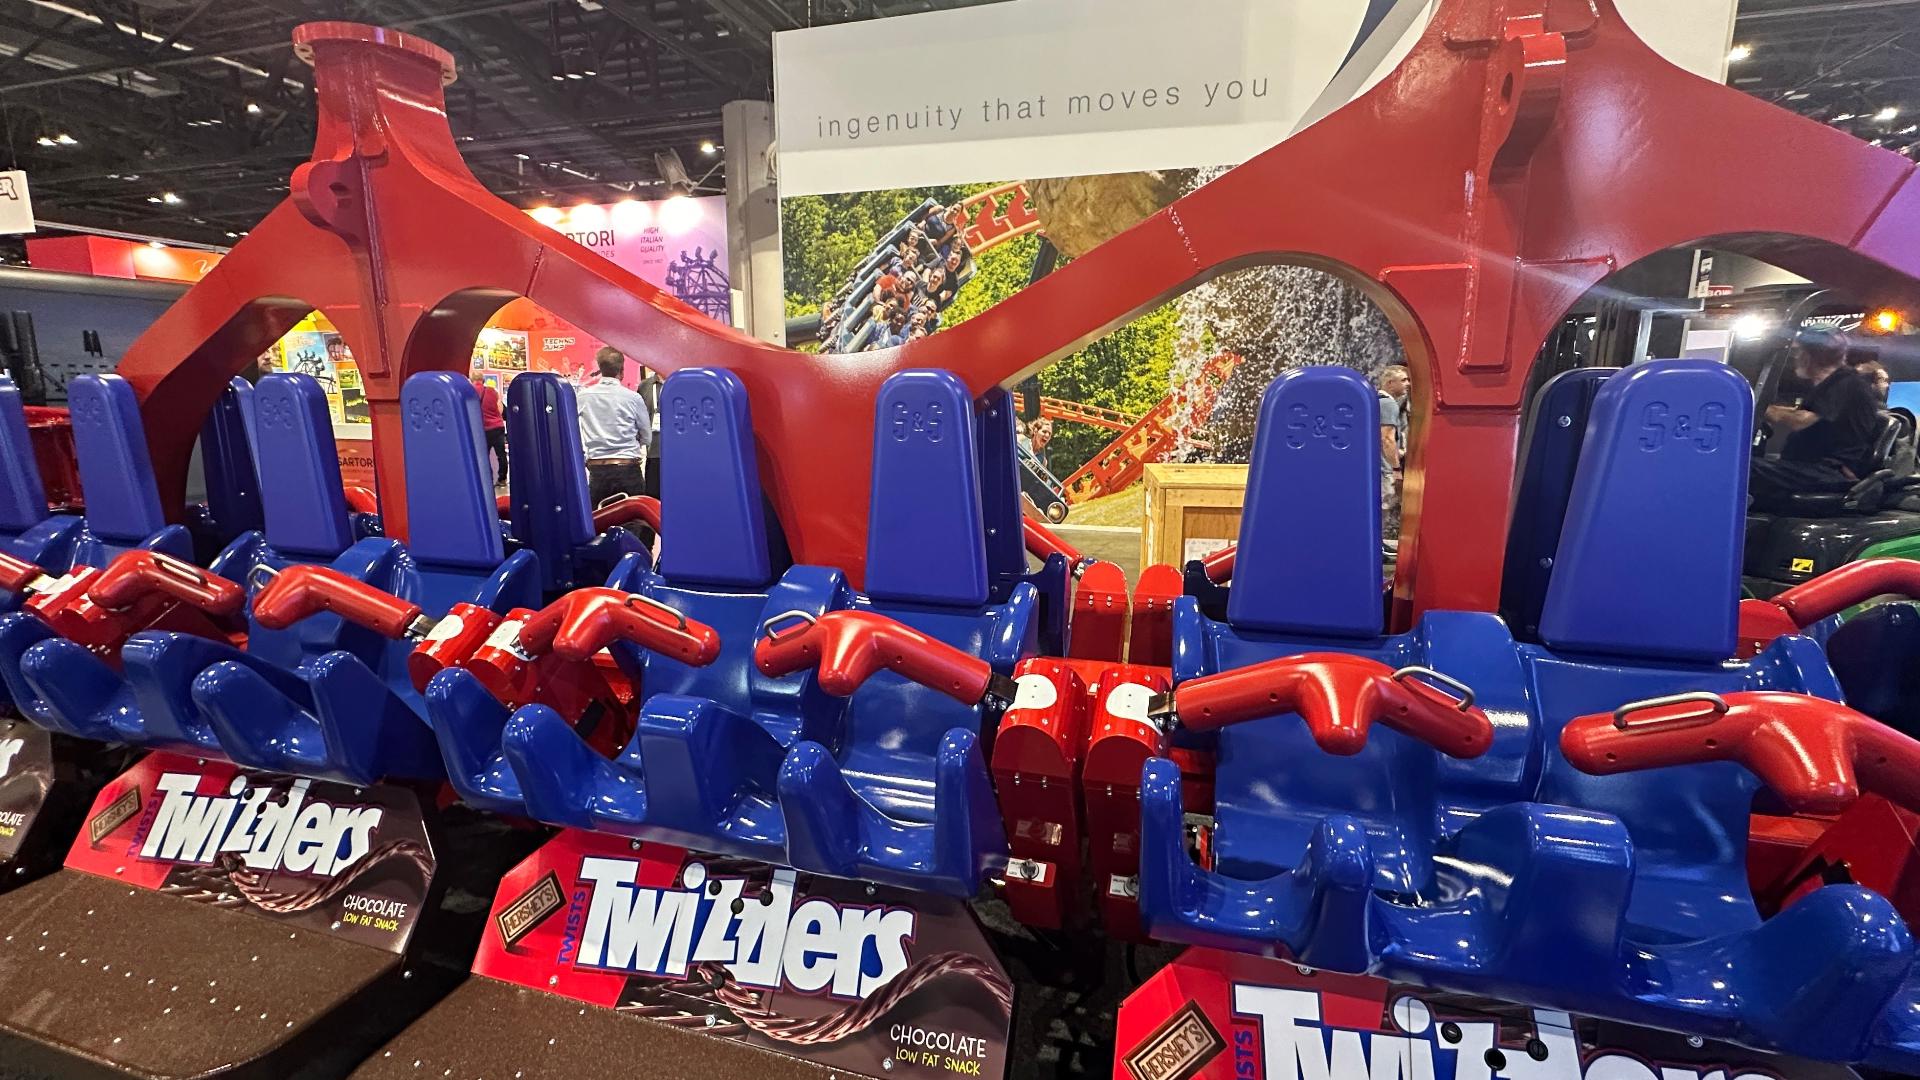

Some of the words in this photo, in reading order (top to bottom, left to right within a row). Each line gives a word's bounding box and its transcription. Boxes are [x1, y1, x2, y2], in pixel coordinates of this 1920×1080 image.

[818, 104, 962, 140] ingenuity
[982, 95, 1047, 121] that
[1067, 82, 1181, 116] moves
[1204, 75, 1268, 107] you
[640, 236, 664, 244] ITALIAN
[643, 226, 659, 234] HIGH
[640, 245, 665, 253] QUALITY
[408, 397, 448, 432] S&S
[672, 396, 715, 435] S&S
[892, 401, 944, 443] S&S
[1286, 402, 1355, 451] S&S
[1638, 401, 1727, 453] S&S
[343, 894, 408, 918] CHOCOLATE
[343, 911, 359, 924] LOW
[360, 915, 373, 926] FAT
[374, 917, 399, 932] SNACK
[505, 886, 553, 933] HERSHEY'S
[558, 890, 586, 965] TWISTS
[890, 1023, 987, 1058] CHOCOLATE
[1141, 1023, 1205, 1080] HERSHEY'S
[895, 1046, 918, 1064] LOW
[921, 1052, 940, 1068] FAT
[944, 1056, 980, 1077] SNACK
